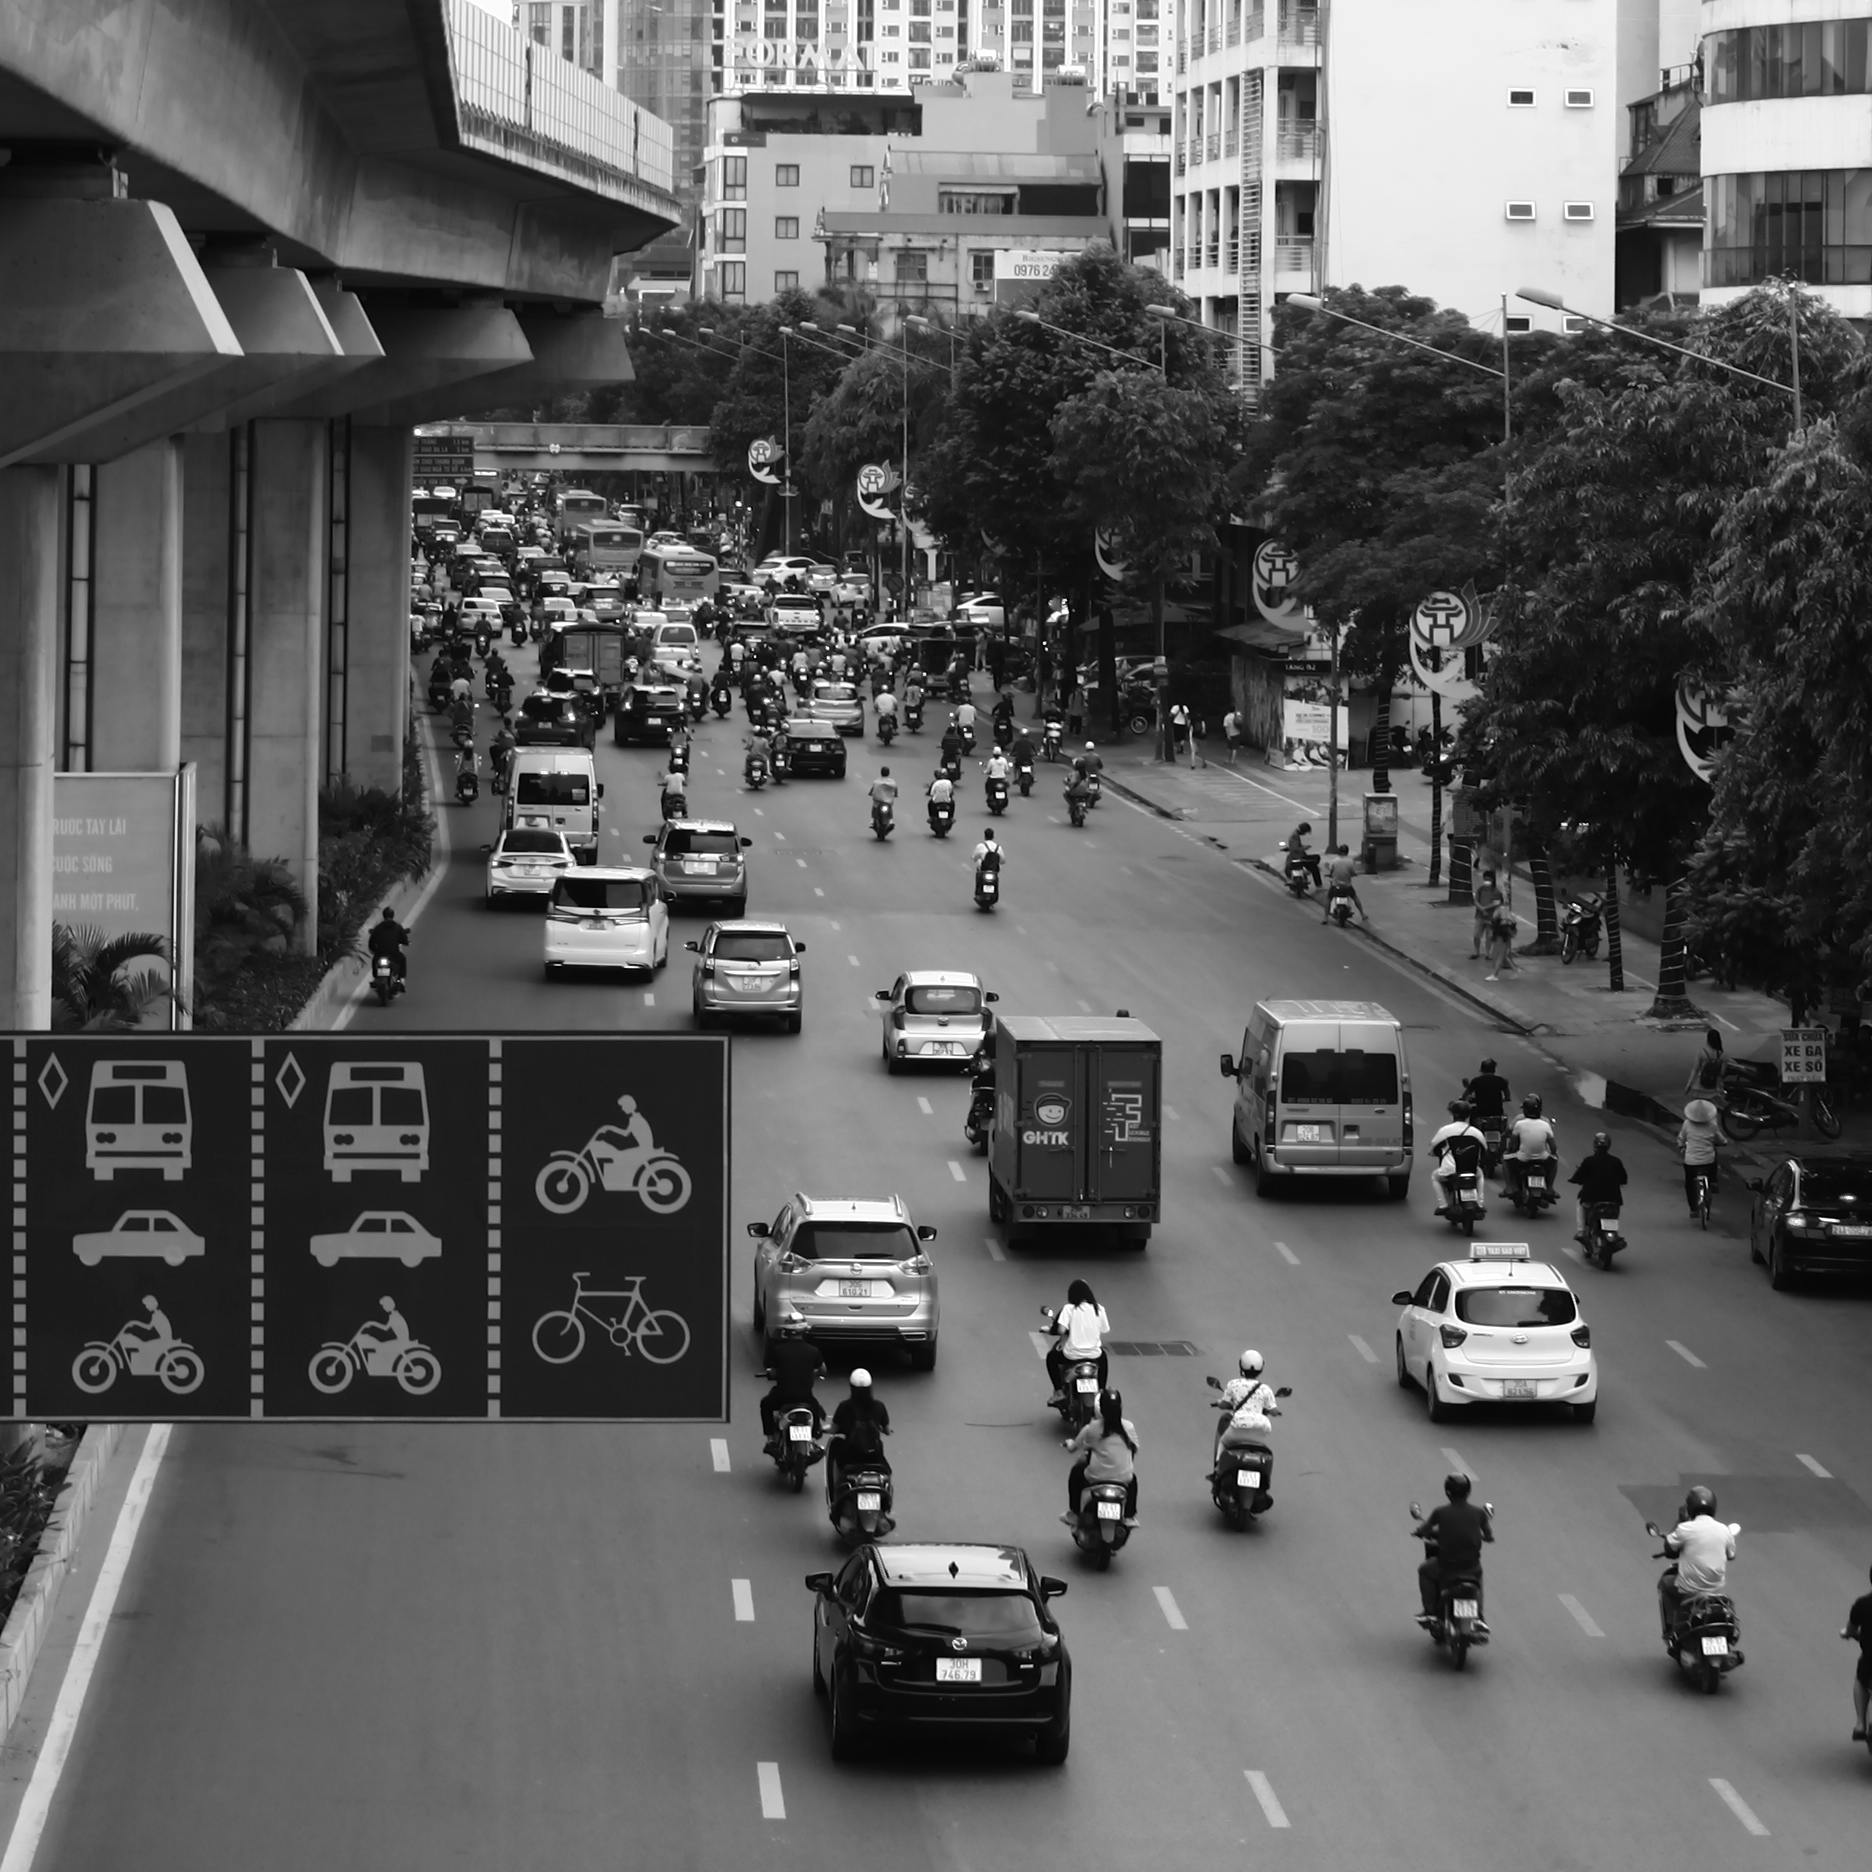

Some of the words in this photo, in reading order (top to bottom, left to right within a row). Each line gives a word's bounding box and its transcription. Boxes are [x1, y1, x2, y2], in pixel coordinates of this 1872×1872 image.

[726, 37, 879, 70] FORMAT
[1014, 264, 1041, 277] 0976
[1784, 1045, 1801, 1057] XE
[1805, 1045, 1823, 1057] GA
[1784, 1061, 1801, 1073] XE
[1022, 1130, 1069, 1146] GHTK
[941, 1669, 976, 1680] 746.79
